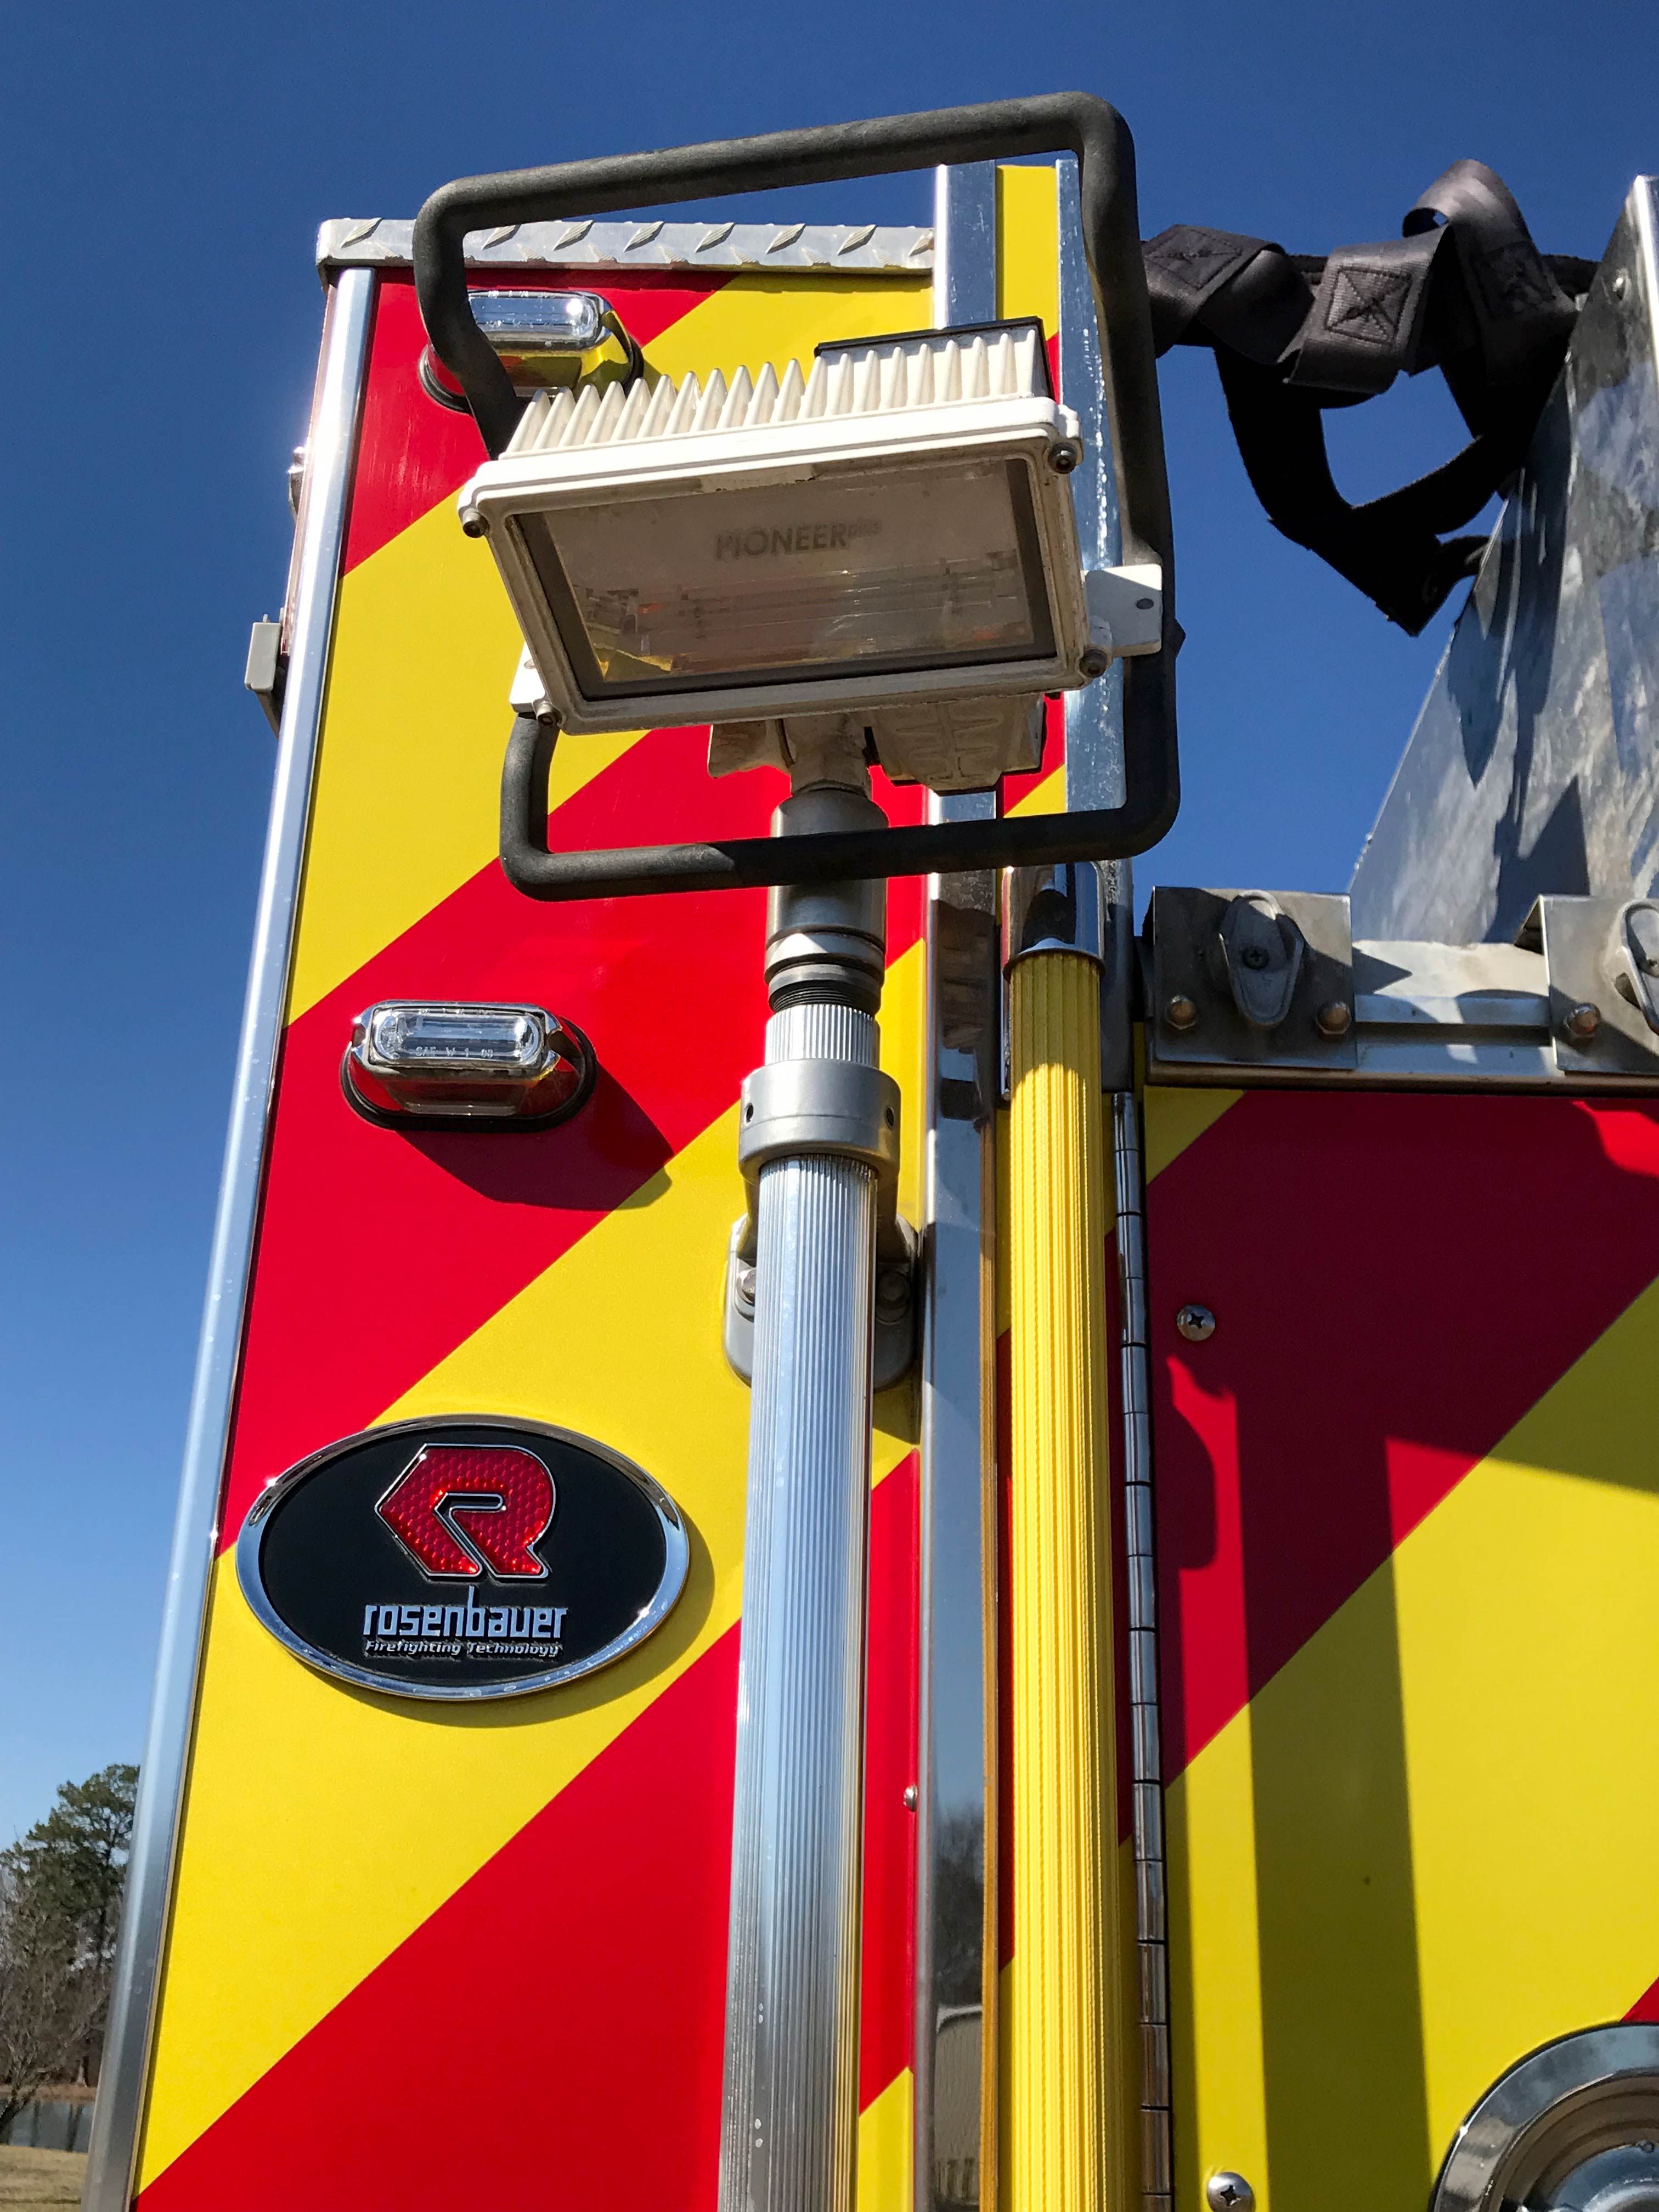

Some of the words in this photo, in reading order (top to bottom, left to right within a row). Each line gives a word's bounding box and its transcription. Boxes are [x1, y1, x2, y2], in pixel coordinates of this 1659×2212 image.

[715, 523, 848, 560] PIONEER
[363, 1585, 567, 1638] rosenbauer
[365, 1640, 461, 1656] Firefighting
[469, 1642, 559, 1657] Technology
